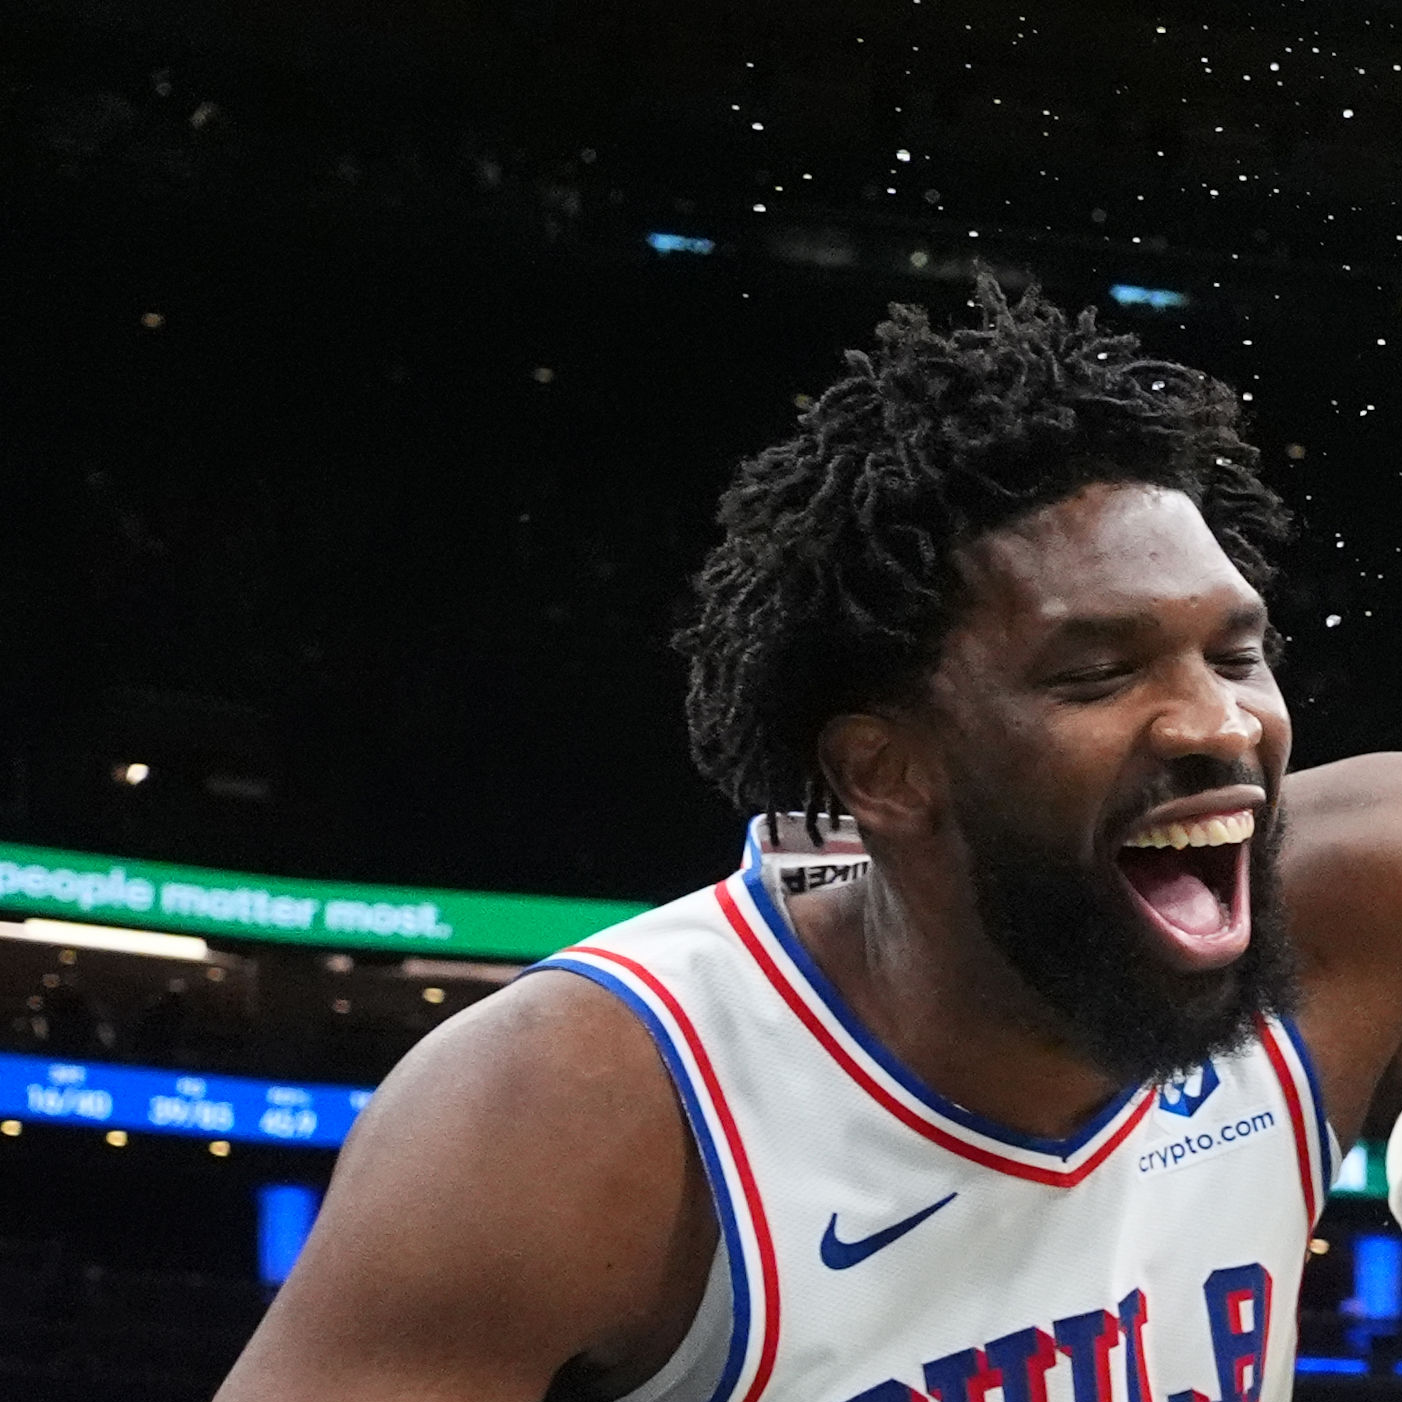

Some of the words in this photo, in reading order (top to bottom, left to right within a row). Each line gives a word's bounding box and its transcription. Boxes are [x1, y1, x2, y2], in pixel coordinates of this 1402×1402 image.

[160, 882, 316, 930] matter
[323, 900, 453, 940] most.
[1138, 1111, 1276, 1172] crypto.com
